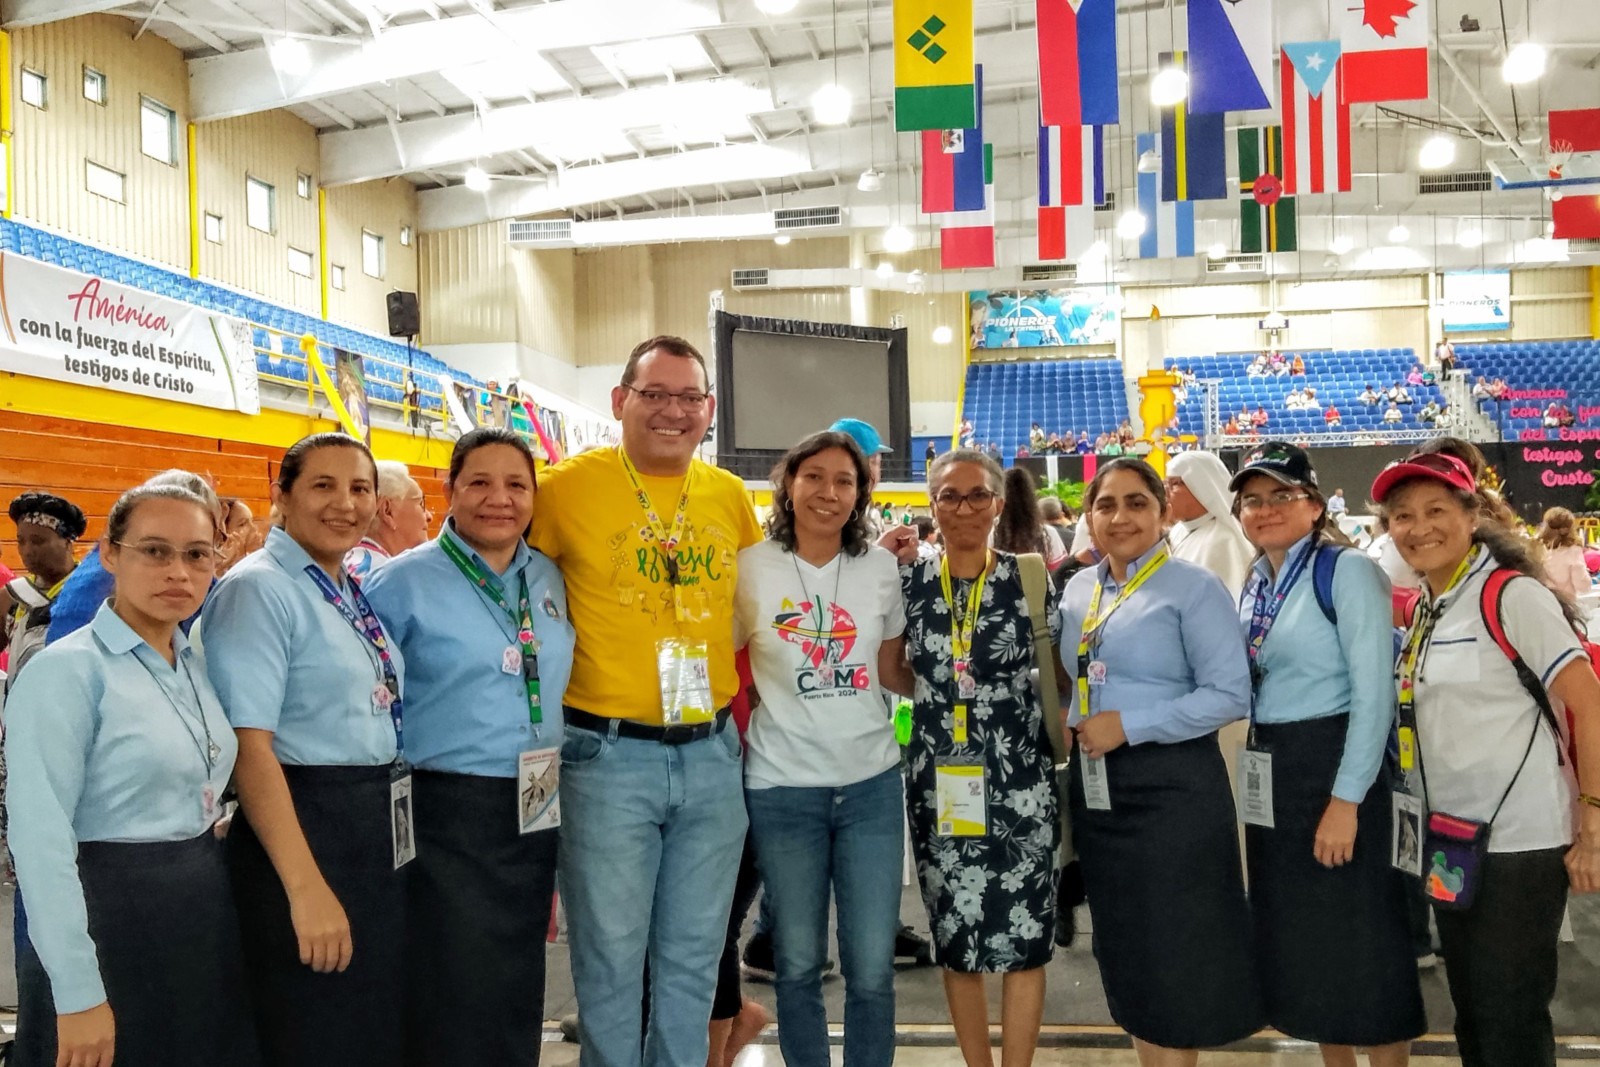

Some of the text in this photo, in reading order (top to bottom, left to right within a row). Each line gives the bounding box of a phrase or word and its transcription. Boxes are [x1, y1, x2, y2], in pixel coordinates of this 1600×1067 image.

[68, 278, 175, 338] América,
[986, 315, 1057, 328] PIONEROS
[20, 318, 216, 376] con la fuerza del Espíritu,
[64, 354, 194, 394] testigos de Cristo
[1510, 407, 1541, 418] con
[1520, 427, 1546, 441] del
[1523, 447, 1584, 466] testigos
[1541, 469, 1595, 487] Cristo
[797, 666, 869, 692] CM6
[838, 689, 857, 697] 2024
